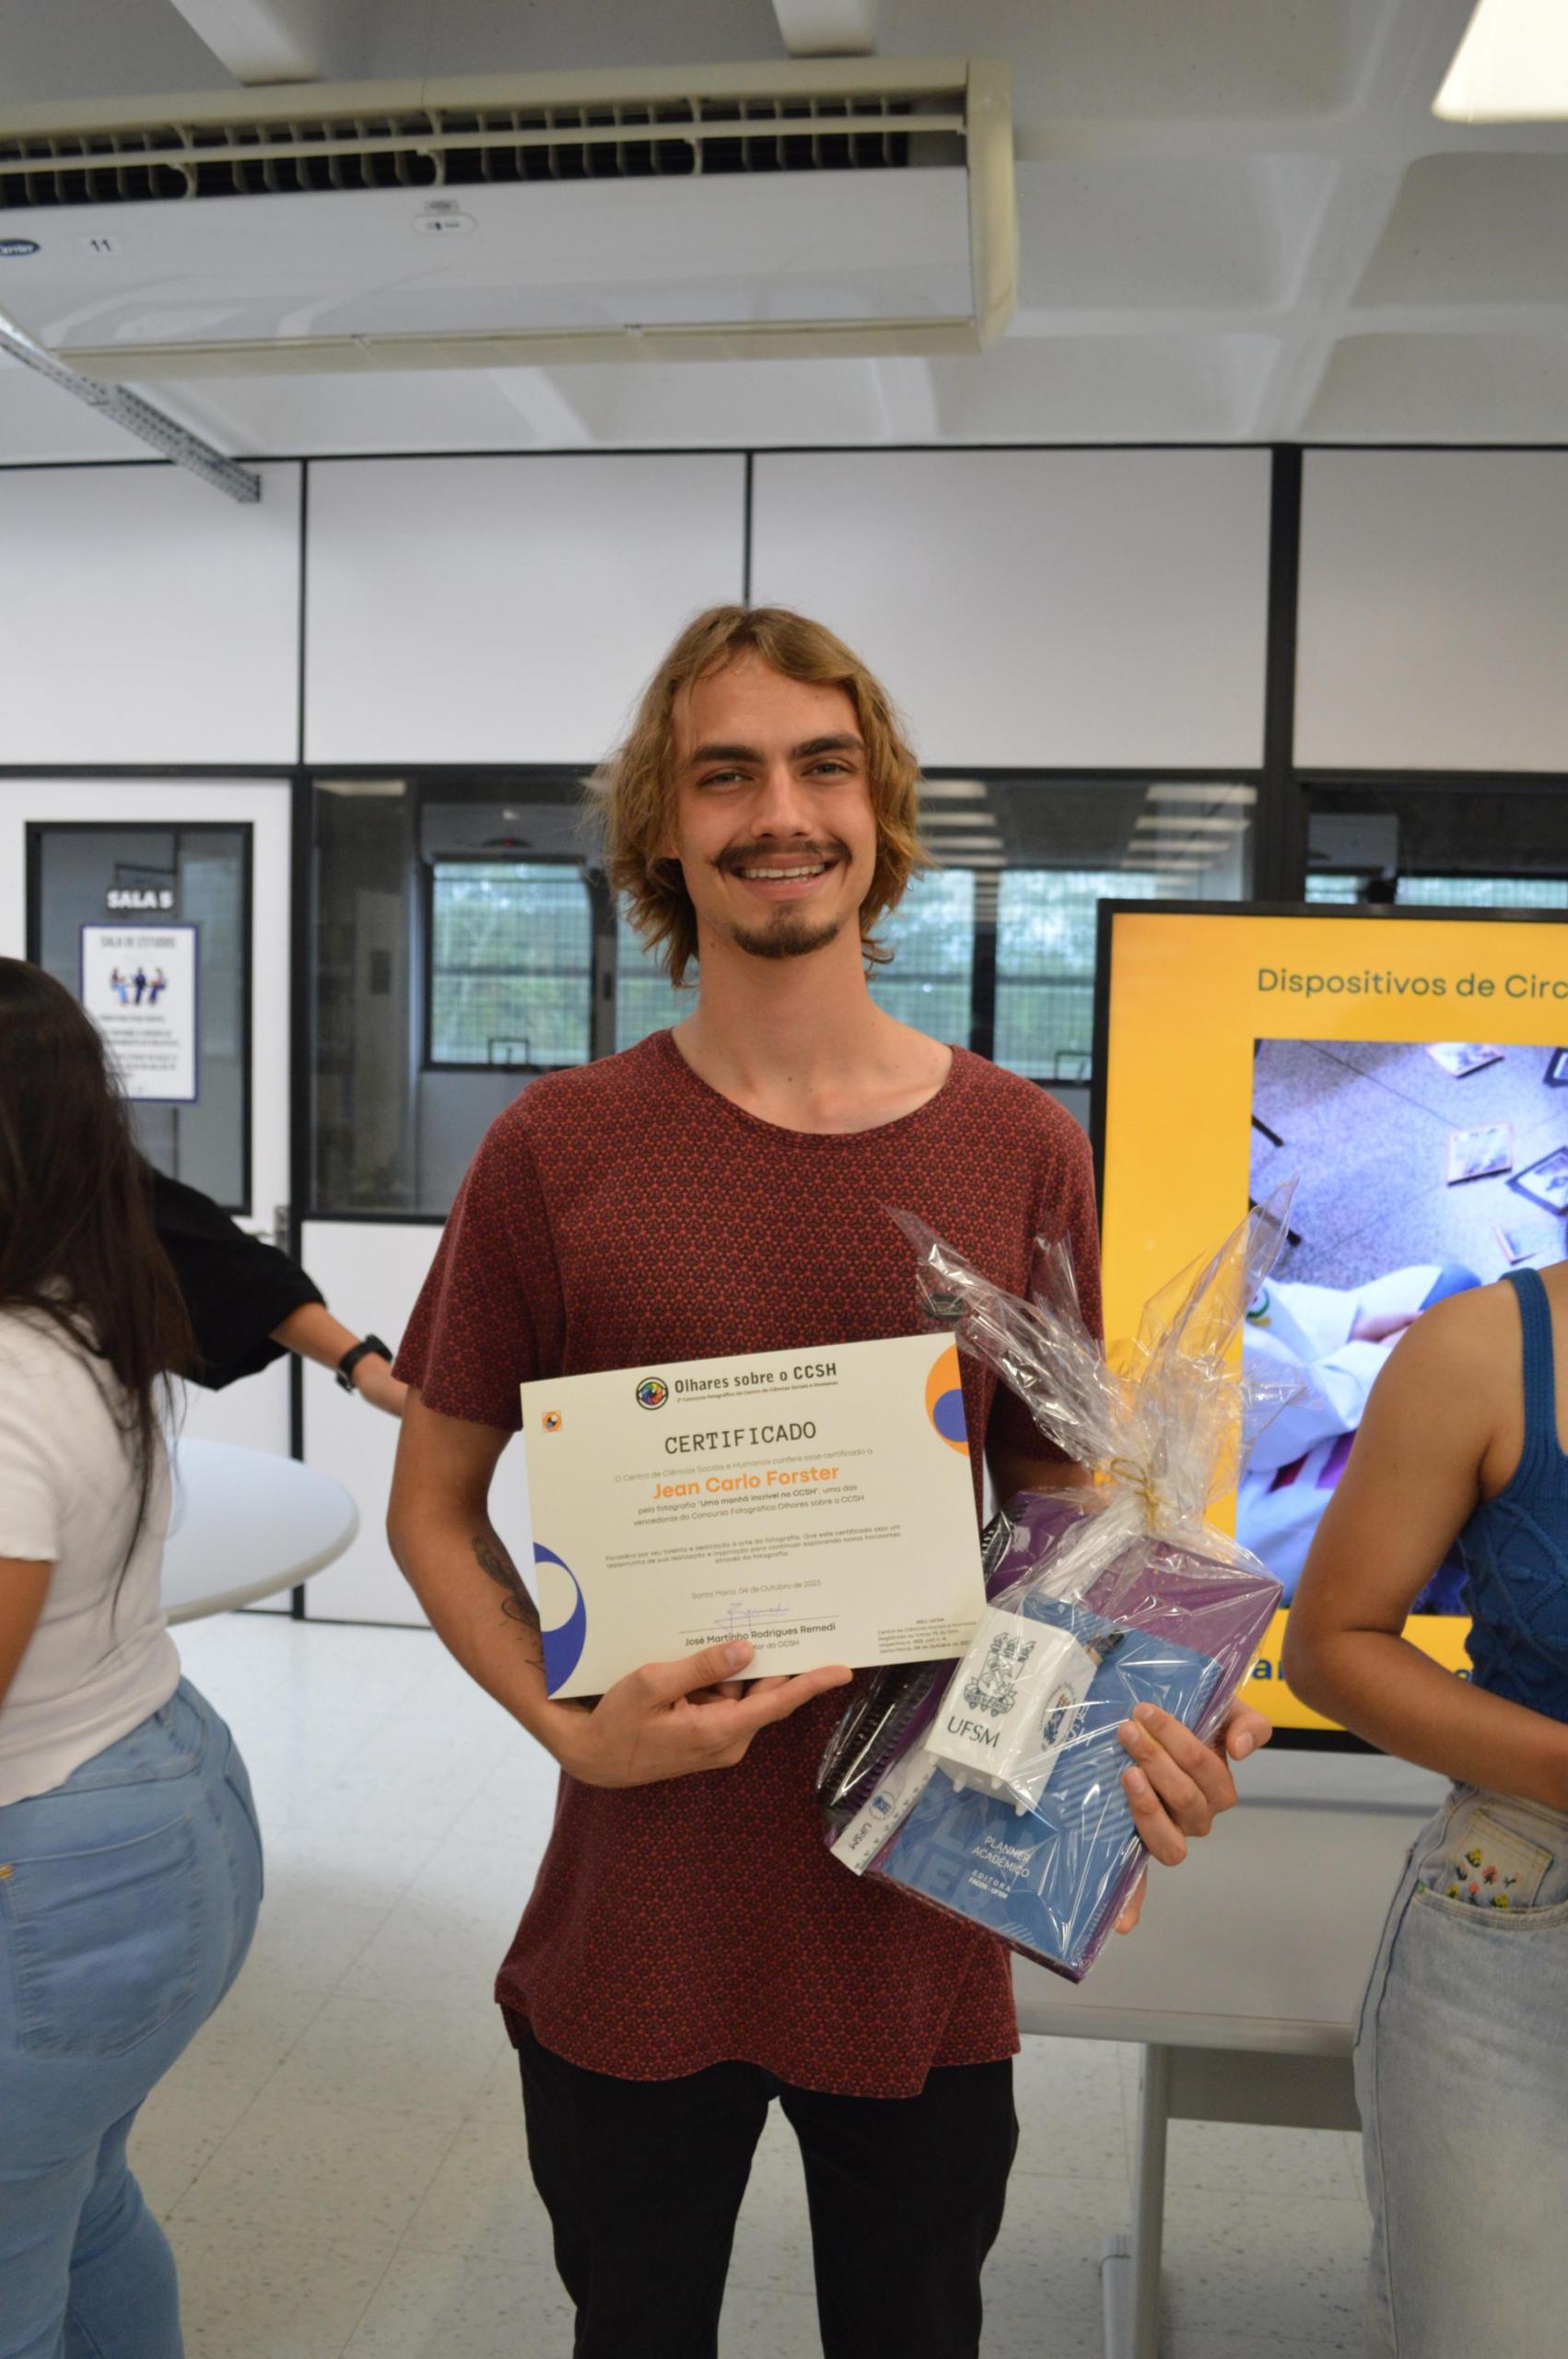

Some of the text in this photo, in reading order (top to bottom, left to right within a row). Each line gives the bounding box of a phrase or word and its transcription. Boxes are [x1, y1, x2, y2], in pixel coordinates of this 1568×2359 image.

[0, 243, 34, 255] arrier
[107, 890, 158, 910] SALA
[1257, 968, 1447, 998] Dispositivos
[1456, 973, 1495, 997] de
[674, 1363, 837, 1393] Olhares sobre o CCSH
[664, 1421, 816, 1454] CERTIFICADO
[823, 1448, 865, 1460] certificado
[652, 1466, 840, 1499] Jean Carlo Forster
[657, 1499, 696, 1511] fotografia
[720, 1495, 749, 1504] manhã
[691, 1511, 728, 1520] Concurso
[778, 1502, 808, 1510] Olhares
[811, 1498, 832, 1507] sobre
[840, 1494, 864, 1503] CCSH
[685, 1622, 836, 1646] José Martinho Rodrigues Remedi
[778, 1638, 800, 1647] CCSH
[947, 1715, 1000, 1748] UFSM
[984, 1835, 1032, 1863] PLANNER
